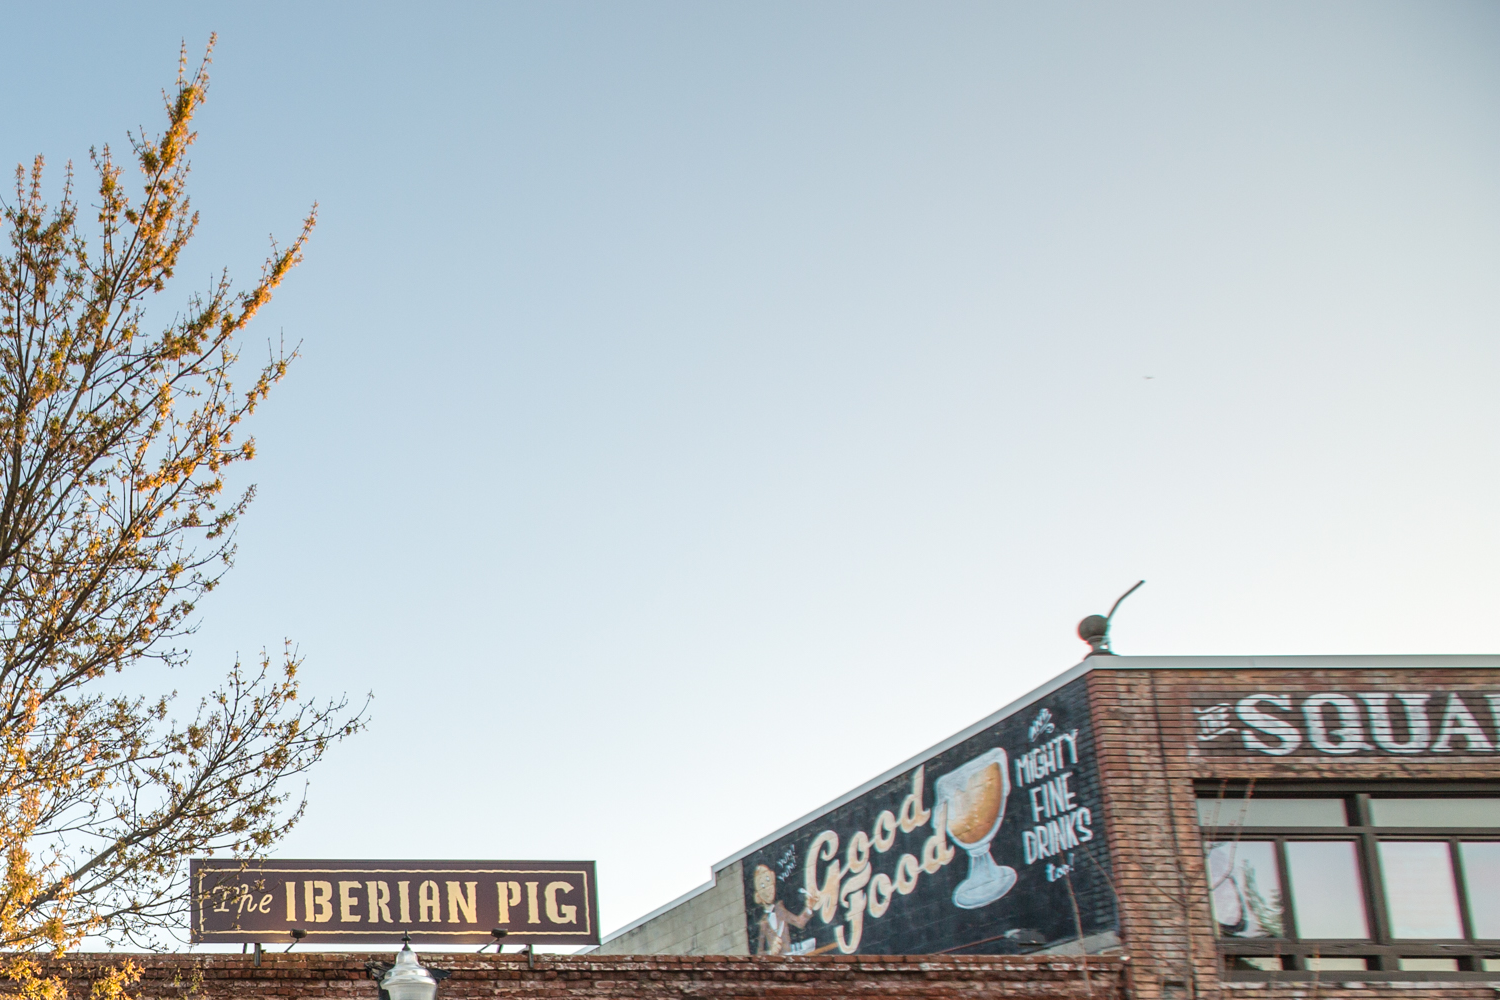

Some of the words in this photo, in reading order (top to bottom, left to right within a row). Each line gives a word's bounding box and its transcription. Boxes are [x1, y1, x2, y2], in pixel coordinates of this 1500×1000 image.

[1234, 692, 1500, 755] SQUA
[1014, 729, 1079, 788] MIGHTY
[1029, 772, 1078, 822] FINE
[804, 764, 931, 924] Good
[1022, 807, 1093, 865] DRINKS
[212, 883, 274, 914] The
[284, 879, 479, 924] IBERIAN
[496, 880, 578, 925] PIG
[834, 800, 955, 955] Food
